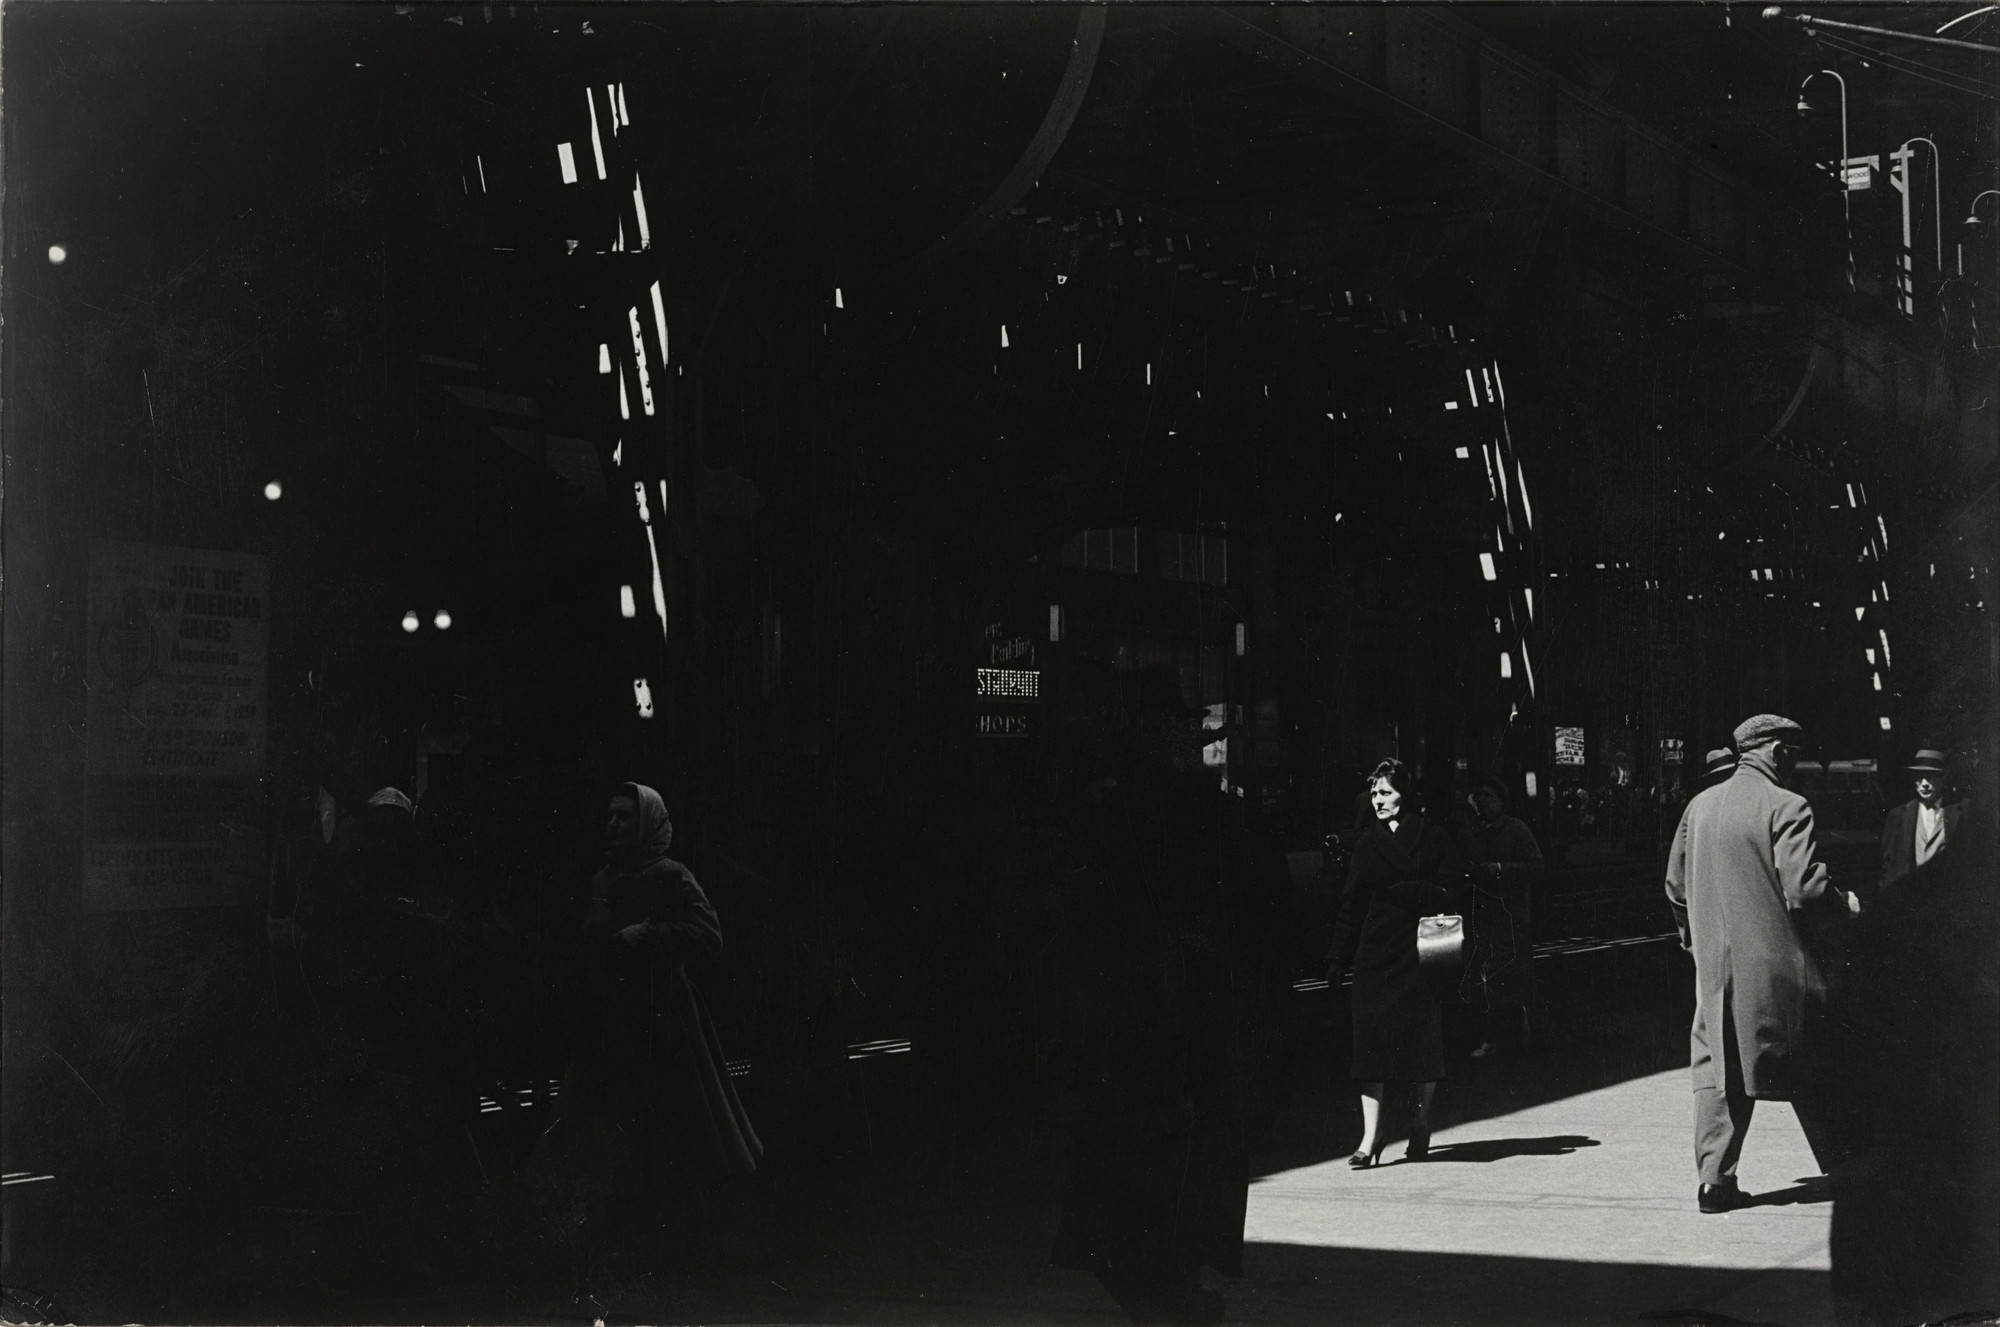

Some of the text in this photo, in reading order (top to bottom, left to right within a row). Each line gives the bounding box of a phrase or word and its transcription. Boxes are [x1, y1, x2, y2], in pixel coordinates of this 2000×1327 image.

[168, 564, 205, 589] JOIN
[213, 568, 244, 592] THE
[148, 589, 261, 619] PAN AMERICAN
[179, 618, 232, 643] GAMES
[170, 641, 238, 665] Association
